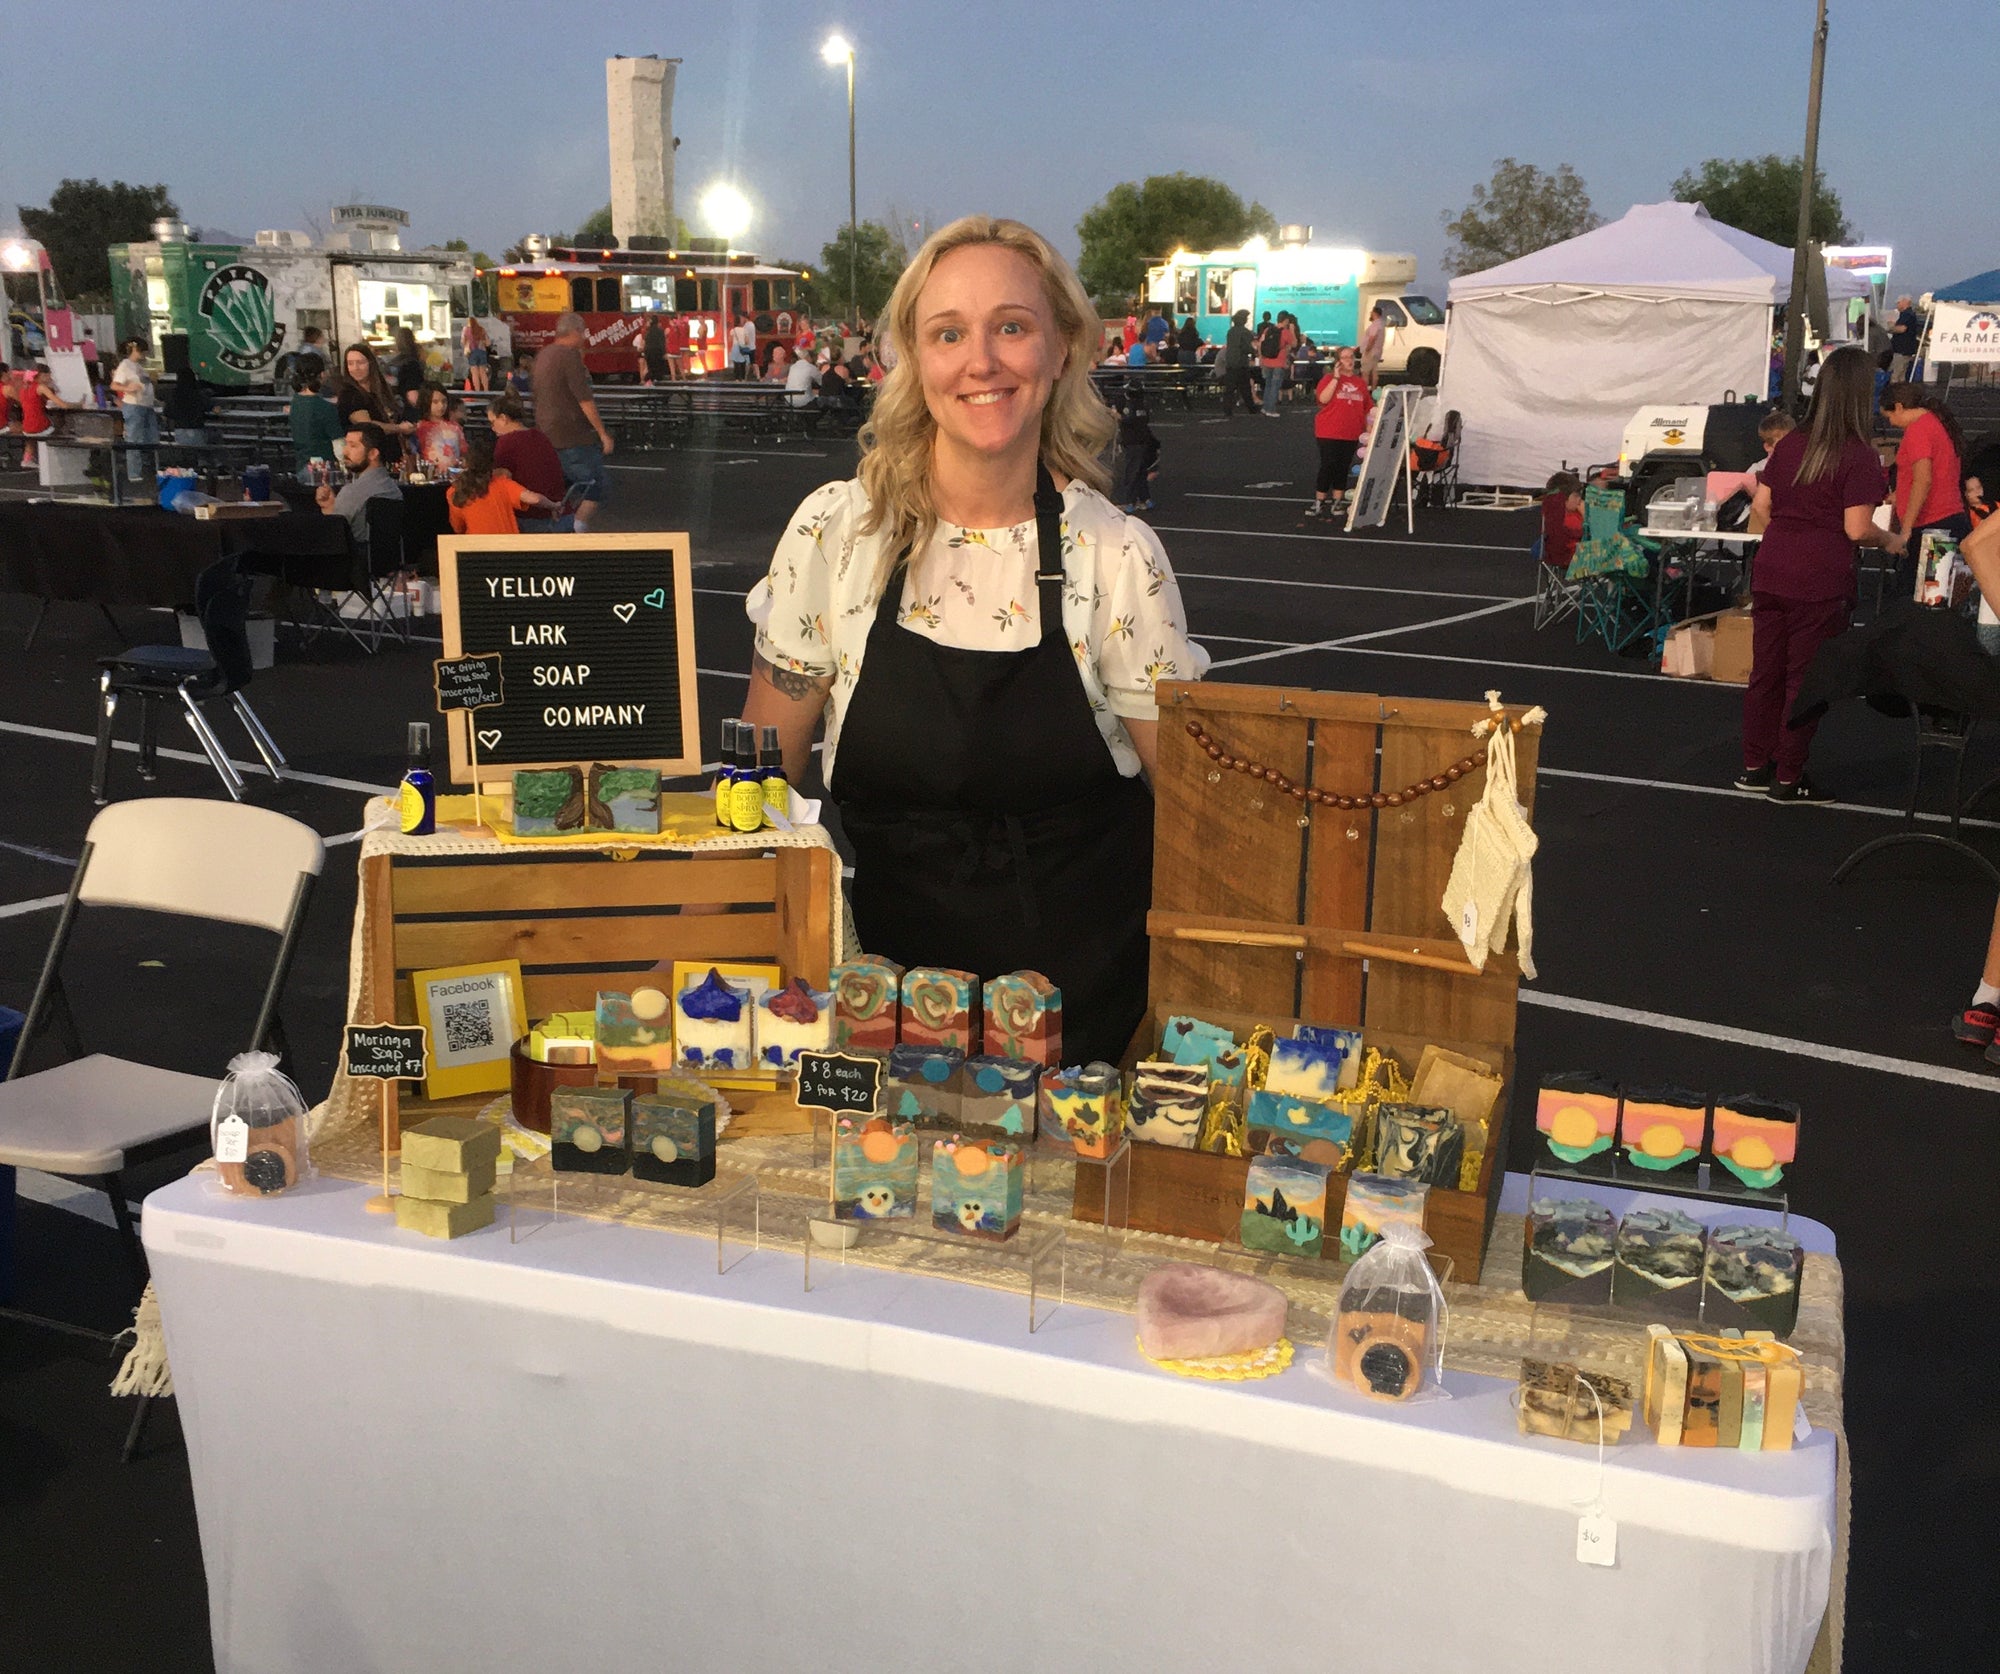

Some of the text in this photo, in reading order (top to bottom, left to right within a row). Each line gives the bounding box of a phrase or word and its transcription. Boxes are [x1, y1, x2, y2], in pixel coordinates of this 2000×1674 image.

[339, 207, 405, 222] PITA JUNGLE
[205, 268, 254, 300] PITA
[588, 319, 625, 347] BURGER
[607, 316, 643, 346] TROLLEY
[1940, 332, 2000, 343] FARME
[224, 326, 285, 368] JUNGLE
[1650, 417, 1688, 427] Allmand
[485, 576, 575, 598] YELLOW
[510, 625, 567, 645] LARK
[533, 664, 590, 686] SOAP
[543, 704, 646, 727] COMPANY
[430, 978, 495, 997] Facebook
[354, 1033, 411, 1049] Moringa
[405, 1059, 422, 1073] $7
[835, 1067, 862, 1079] each
[803, 1080, 812, 1092] 3
[840, 1085, 868, 1102] $20
[1582, 1528, 1600, 1543] $6
